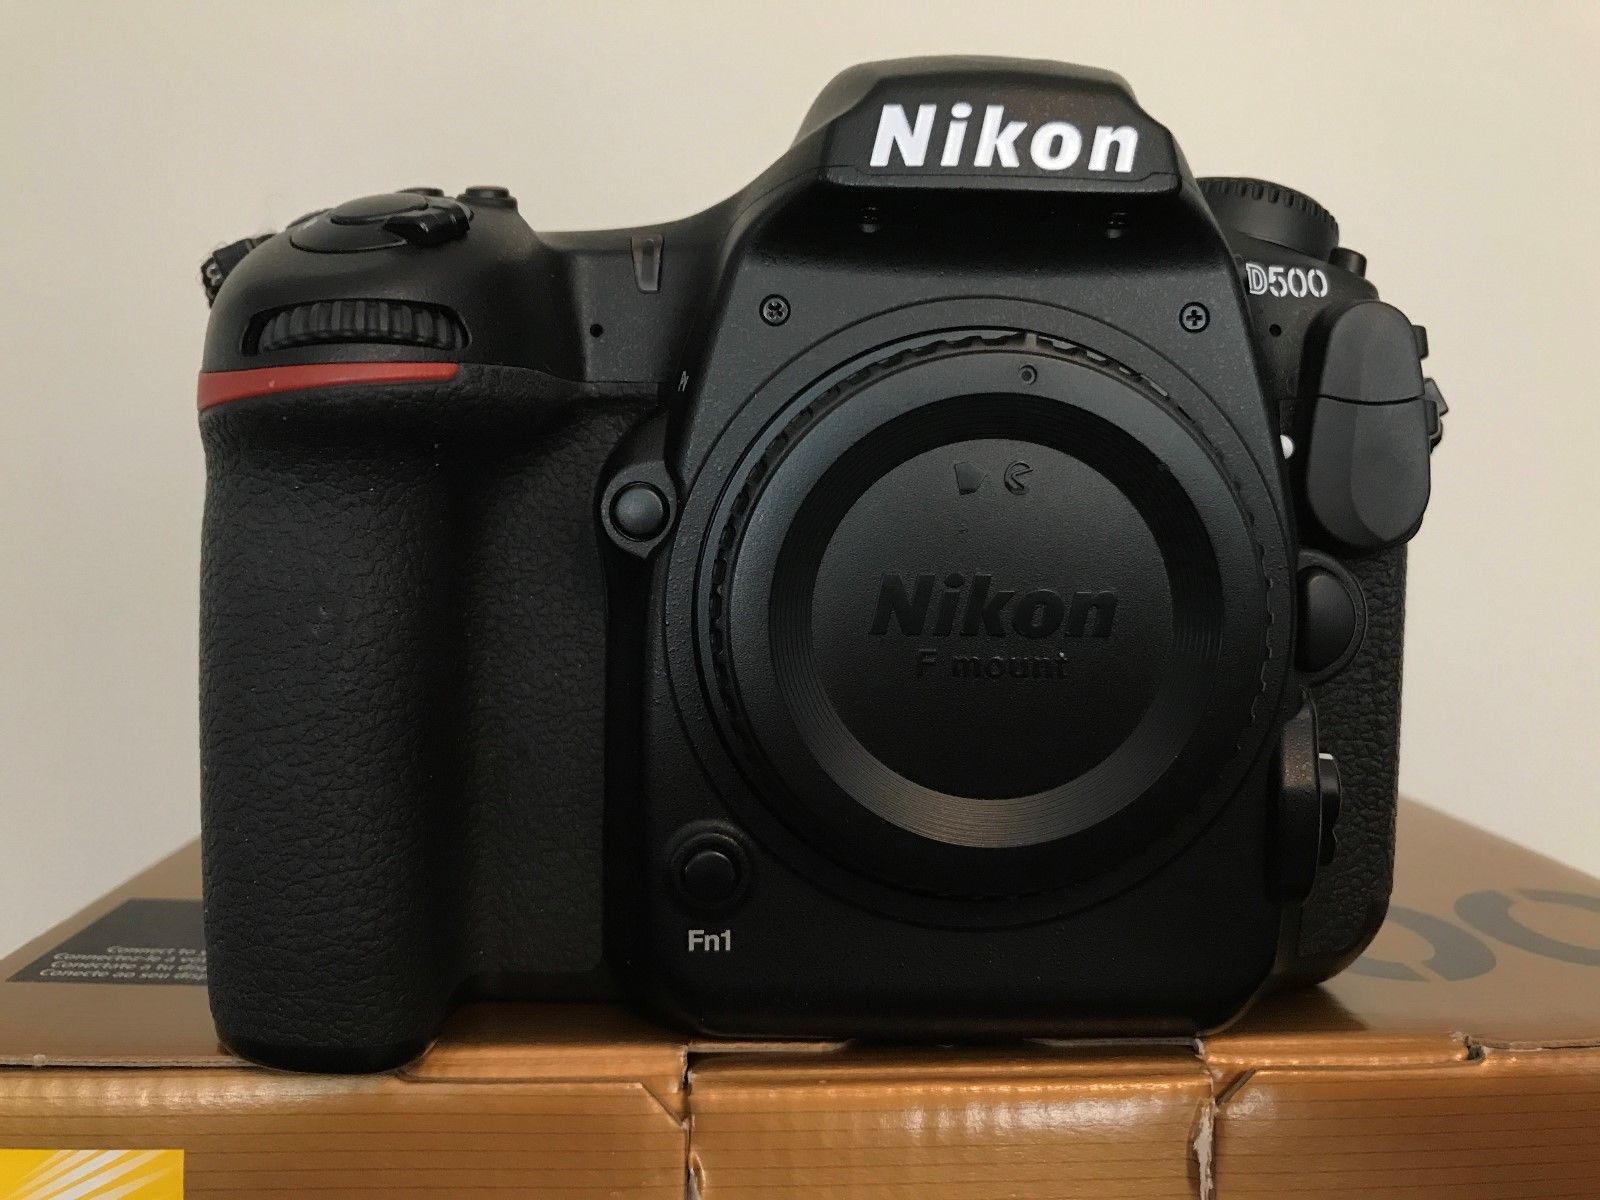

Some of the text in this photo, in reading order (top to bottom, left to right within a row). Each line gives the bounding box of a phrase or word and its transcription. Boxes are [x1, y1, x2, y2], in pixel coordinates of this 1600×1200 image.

[870, 102, 1139, 172] Nikon
[1246, 263, 1328, 298] D500
[867, 572, 1119, 638] Nikon
[918, 648, 1068, 678] F mount
[688, 929, 731, 952] Fn1
